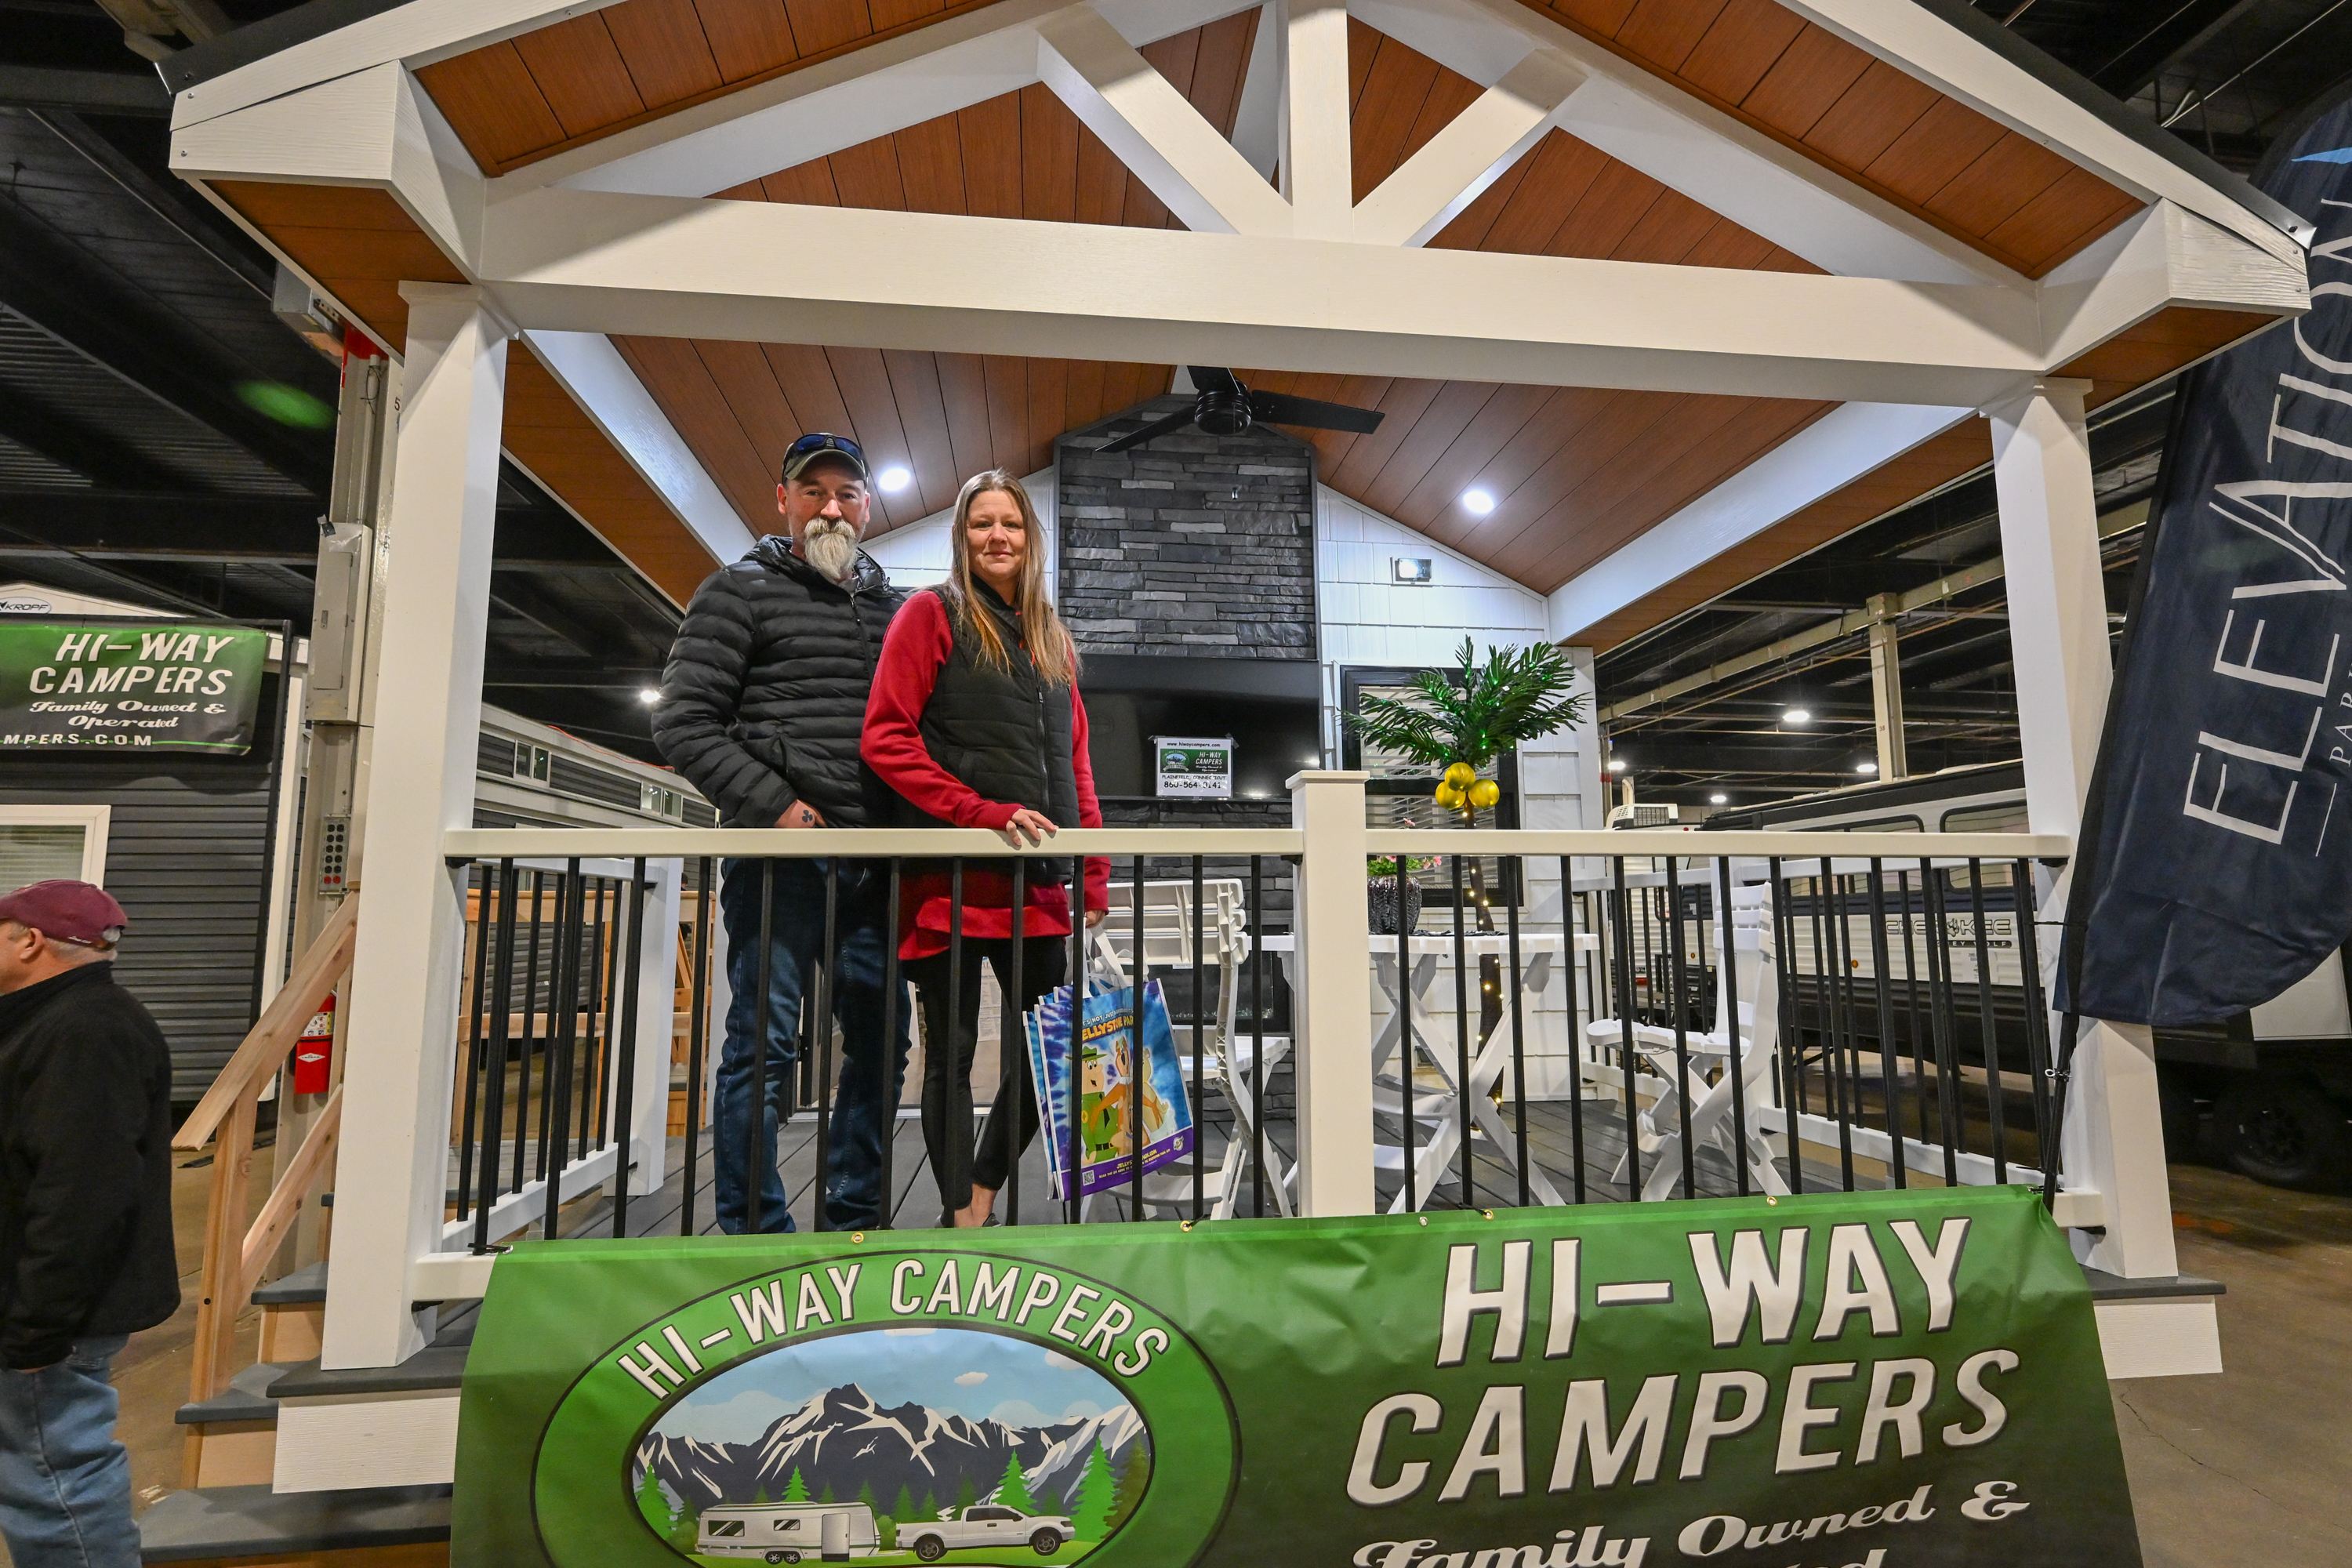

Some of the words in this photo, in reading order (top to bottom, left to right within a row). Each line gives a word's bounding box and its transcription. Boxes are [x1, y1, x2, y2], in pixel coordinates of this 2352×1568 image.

[29, 666, 234, 695] CAMPERS
[55, 632, 235, 662] HI-WAY
[29, 700, 109, 714] Family
[118, 700, 197, 713] Owned
[204, 703, 226, 714] &
[68, 715, 179, 730] Operated
[2329, 662, 2352, 768] PAR
[616, 1263, 862, 1401] HI-WAY
[890, 1257, 1170, 1378] CAMPERS
[1435, 1215, 1972, 1370] HI-WAY
[1346, 1348, 2021, 1508] CAMPERS
[1679, 1483, 1936, 1556] Owned
[1960, 1480, 2031, 1522] &
